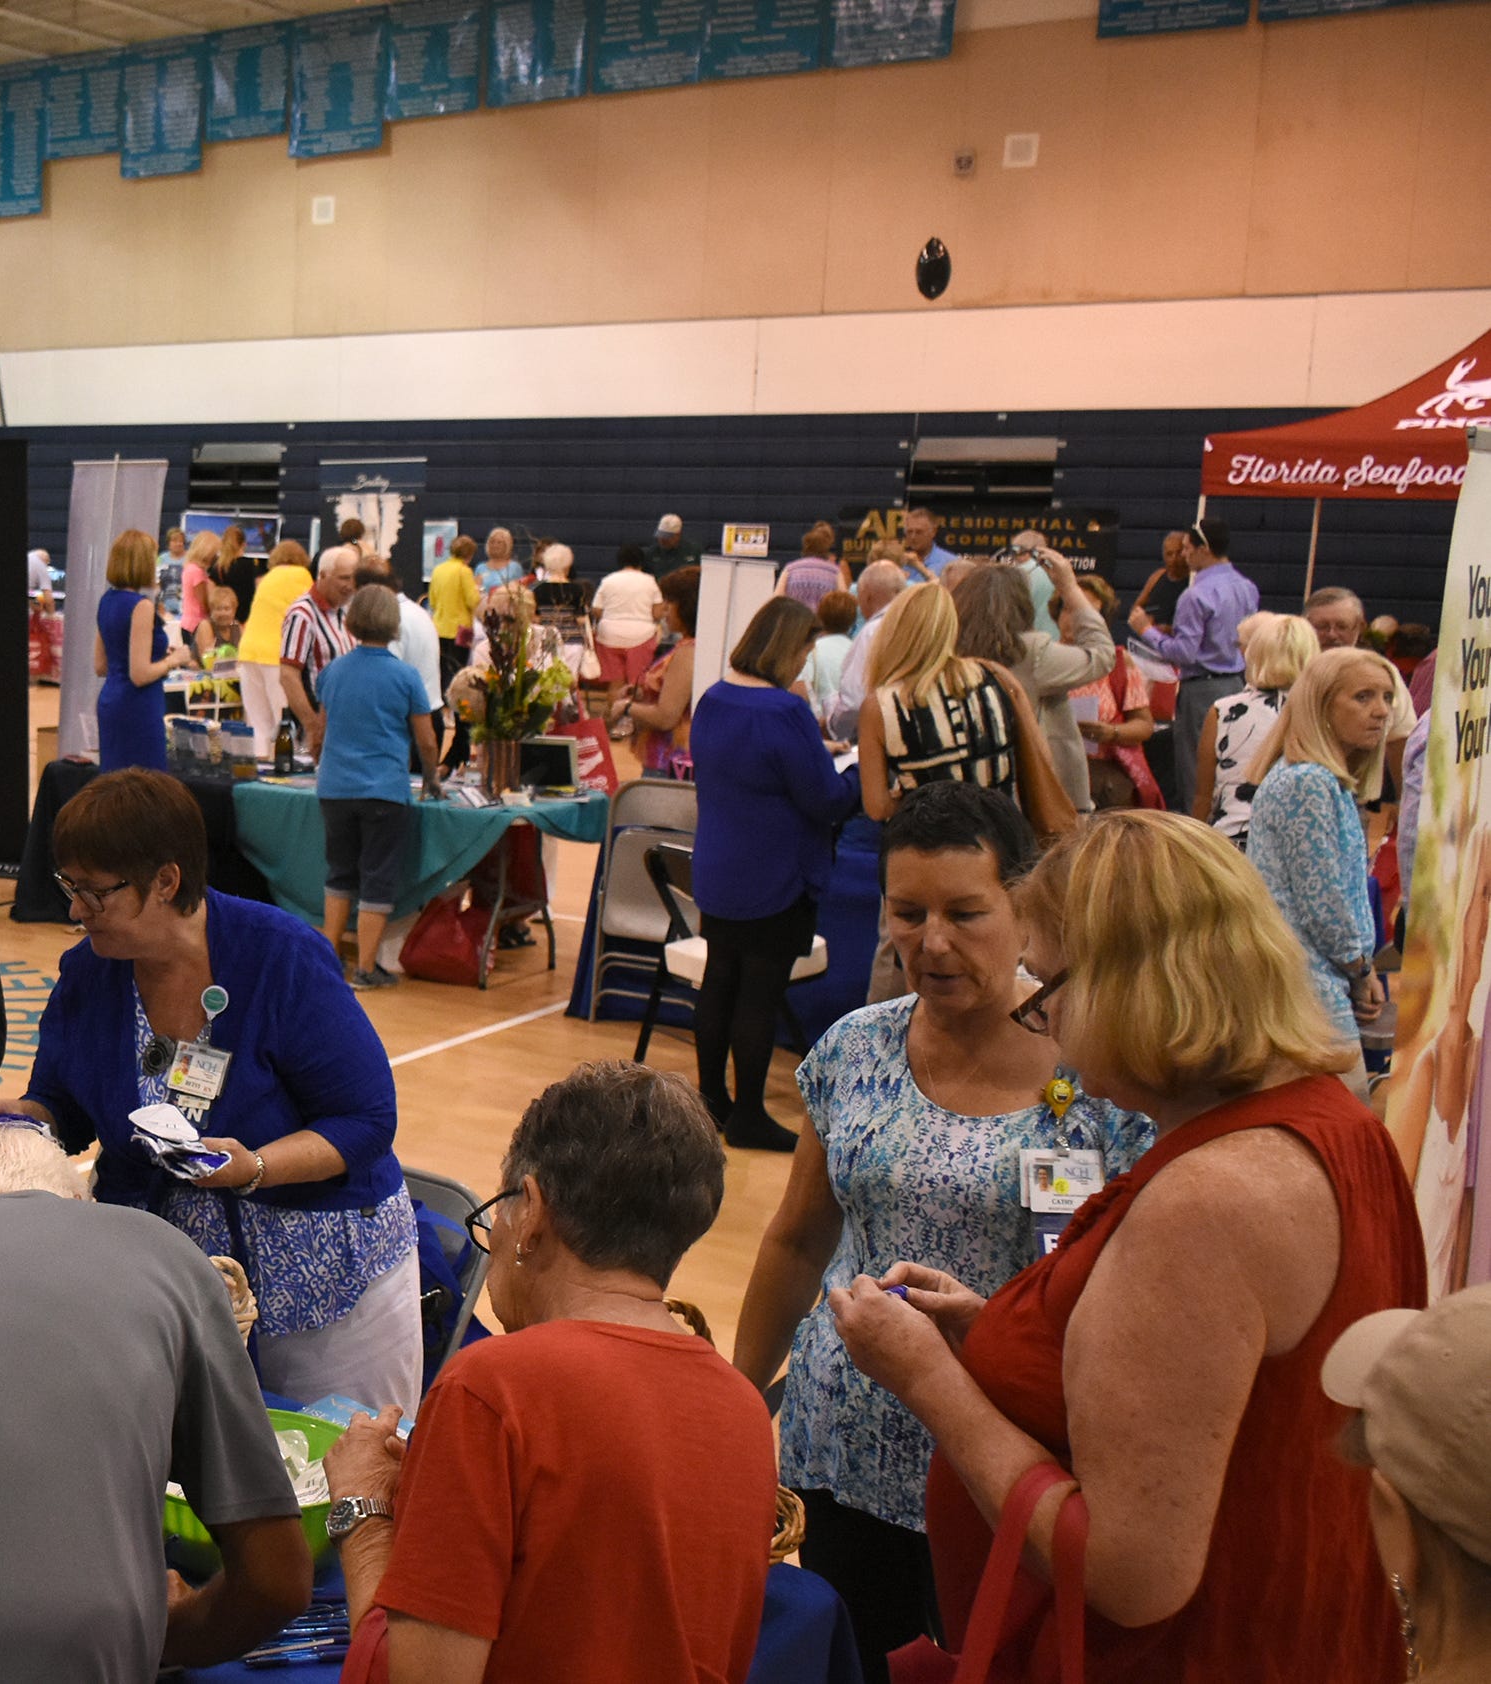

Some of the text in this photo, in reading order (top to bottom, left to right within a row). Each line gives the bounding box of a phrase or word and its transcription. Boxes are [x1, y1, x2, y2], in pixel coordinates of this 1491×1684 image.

[1227, 453, 1340, 485] Florida
[944, 533, 1087, 549] COMMIAL
[1455, 709, 1487, 765] Your
[197, 1059, 218, 1073] NCH
[1064, 1167, 1090, 1178] NCH
